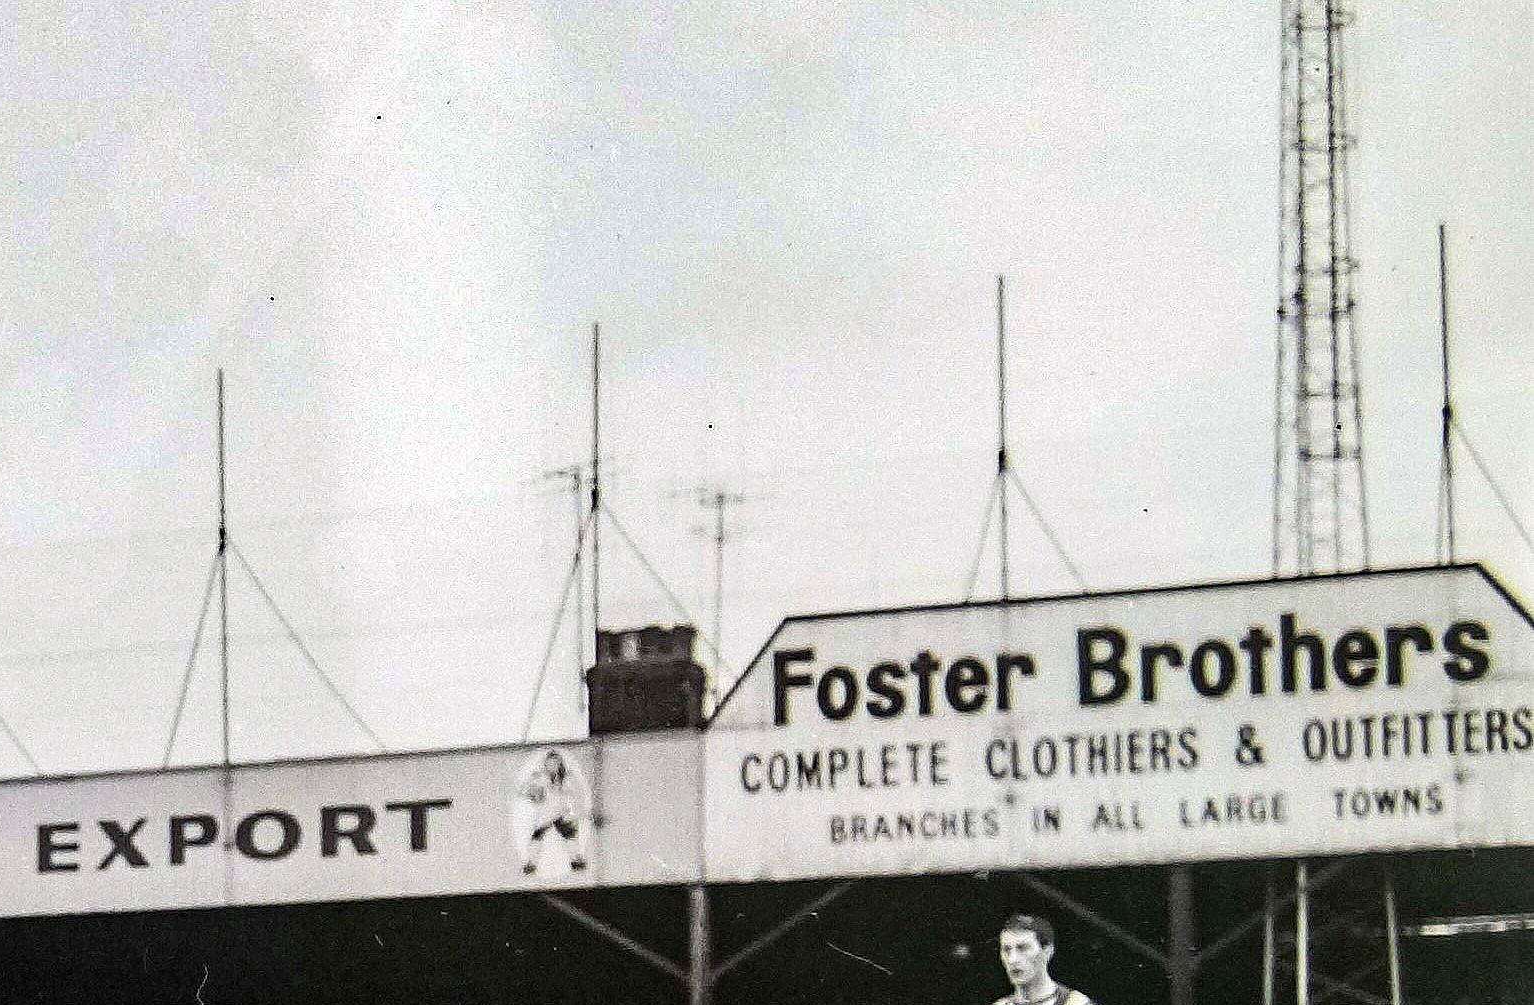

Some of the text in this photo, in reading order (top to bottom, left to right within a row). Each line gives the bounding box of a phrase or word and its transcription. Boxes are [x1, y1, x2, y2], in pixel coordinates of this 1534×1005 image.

[772, 612, 1491, 726] Foster Brothers
[740, 705, 1534, 794] COMPLETE CLOTHIERS & OUTFITTERS
[36, 798, 454, 875] EXPORT
[829, 783, 1444, 844] BRANCHES IN ALL LARGE TOWNS
